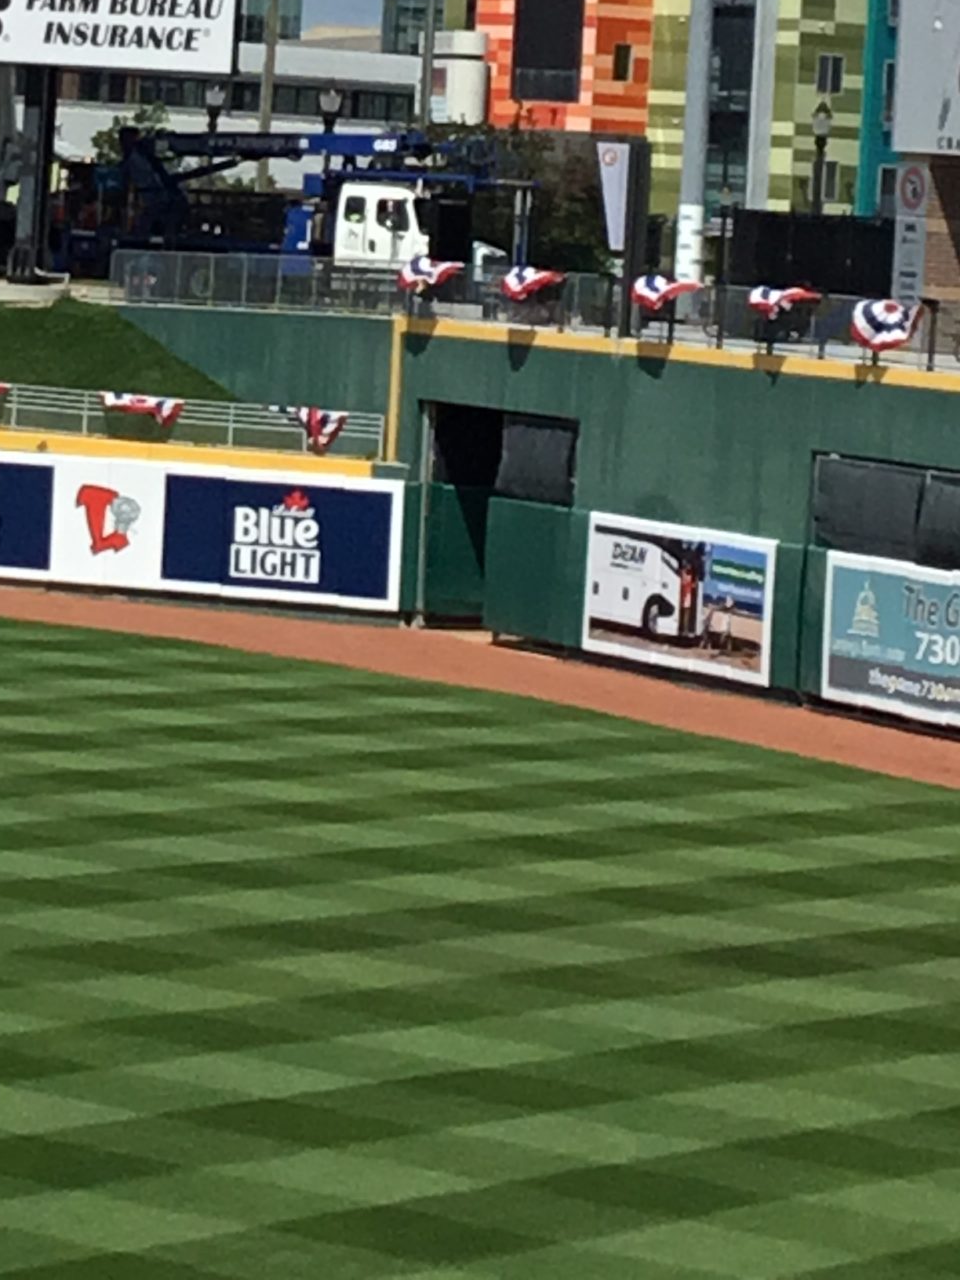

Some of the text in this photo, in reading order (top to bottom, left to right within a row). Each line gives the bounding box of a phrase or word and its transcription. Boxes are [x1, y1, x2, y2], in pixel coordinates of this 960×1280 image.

[43, 20, 201, 52] INSURANCE
[234, 506, 320, 549] Blue
[233, 547, 317, 580] LIGHT
[903, 584, 939, 627] The
[913, 630, 960, 666] 730
